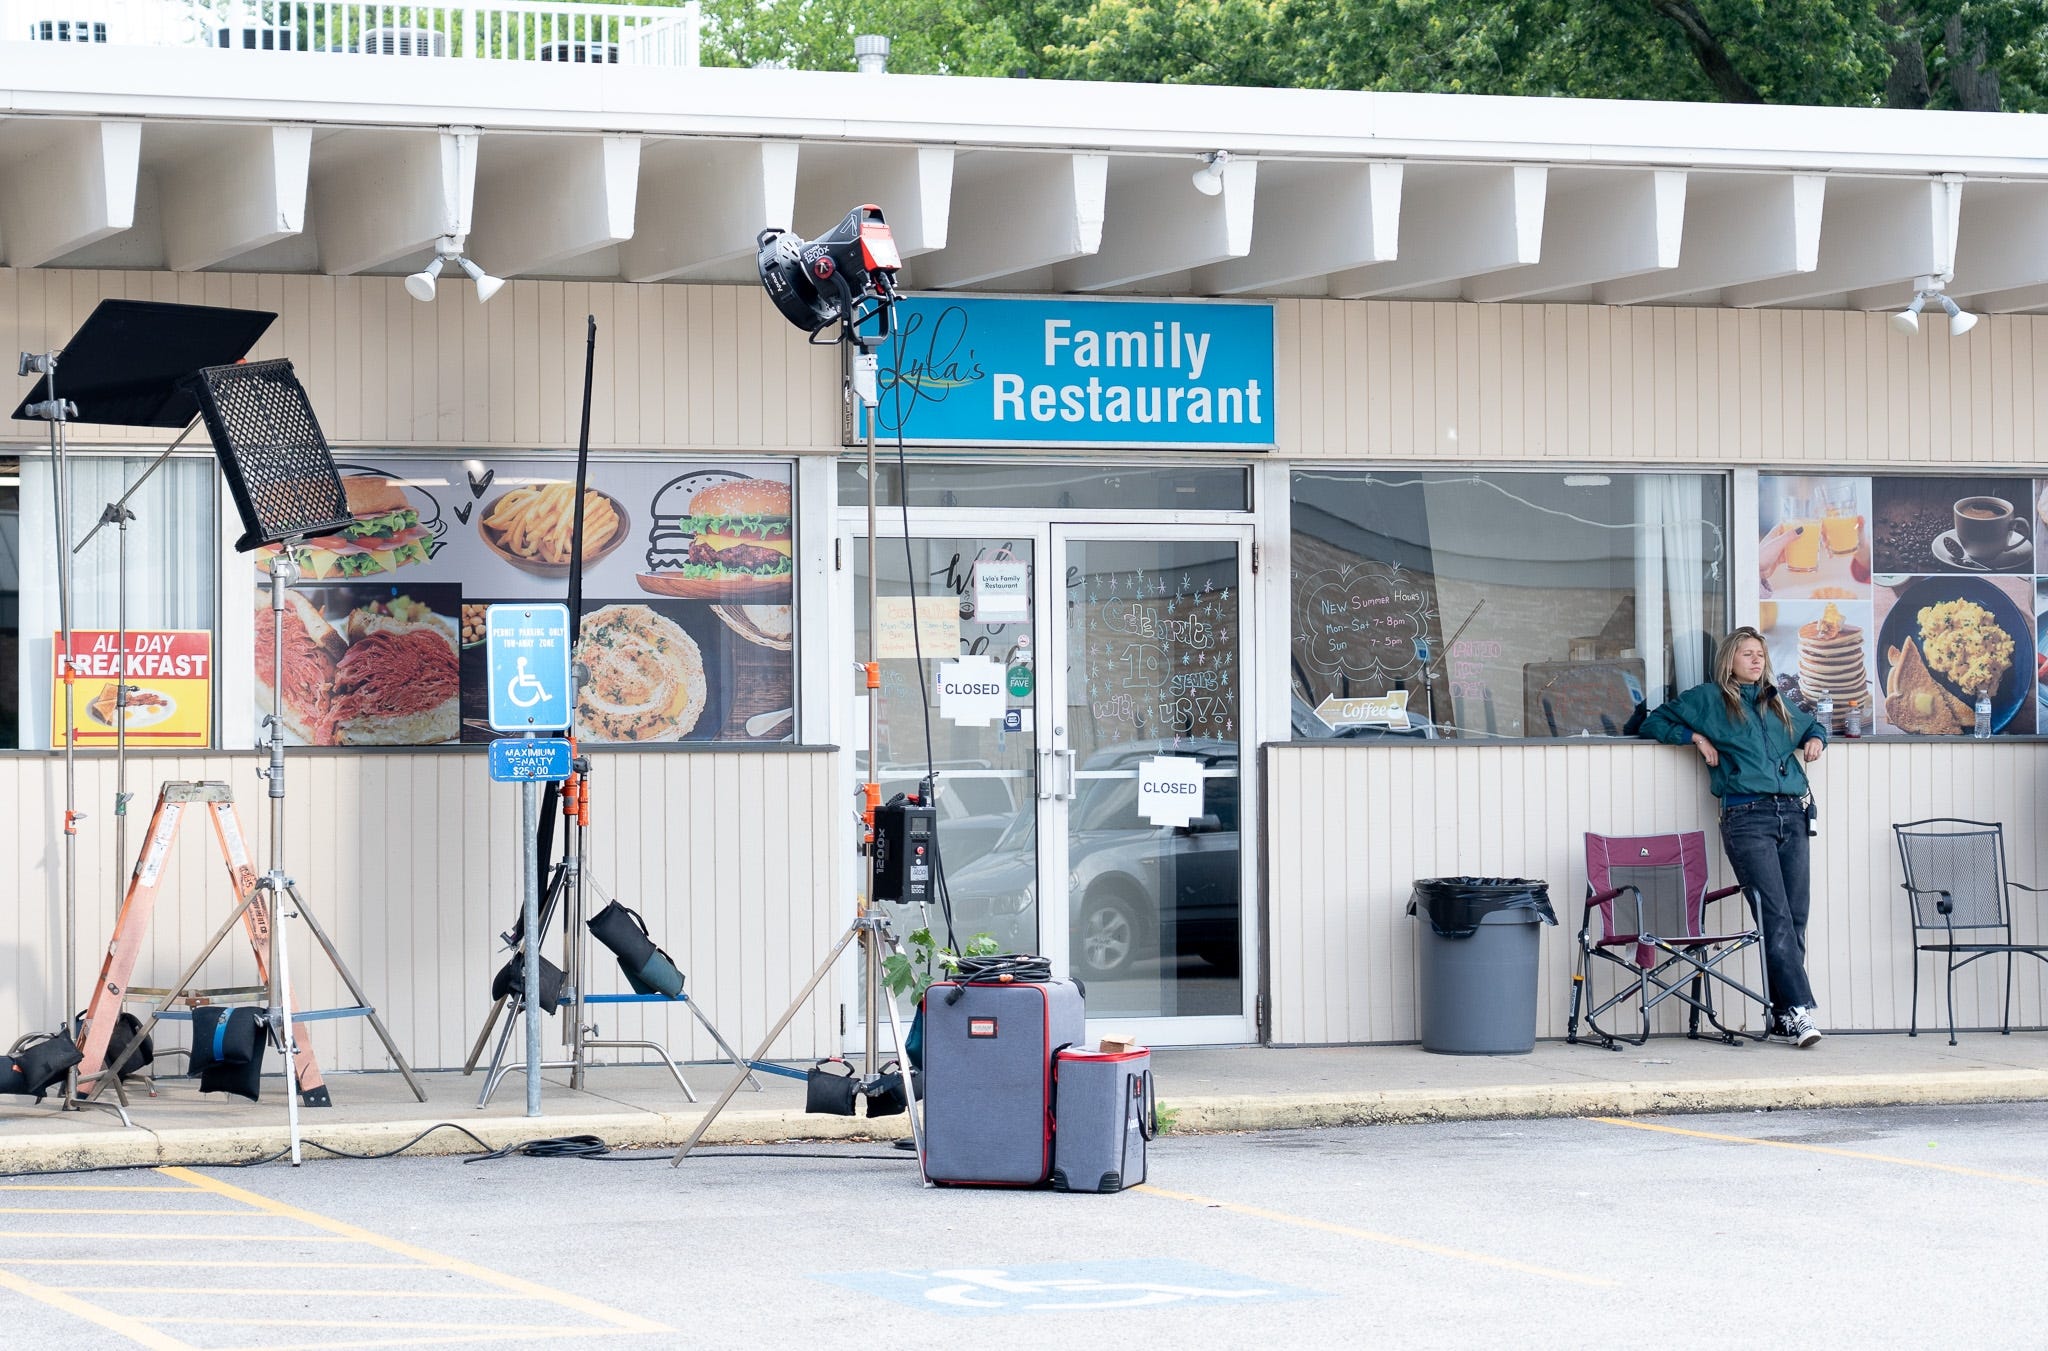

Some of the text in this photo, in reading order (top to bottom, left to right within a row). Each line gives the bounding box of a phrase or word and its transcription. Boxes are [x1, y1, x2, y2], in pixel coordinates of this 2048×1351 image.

[1044, 319, 1211, 380] Family
[877, 306, 985, 431] Lyla's
[993, 374, 1262, 424] Restaurant
[982, 575, 1021, 583] Lyla's Family
[134, 635, 175, 653] DAY
[1328, 638, 1348, 652] Sun
[1120, 644, 1171, 688] 10
[945, 683, 1000, 695] CLOSED
[1010, 680, 1029, 688] FAVE
[1342, 702, 1387, 720] Coffee
[1143, 782, 1197, 795] CLOSED
